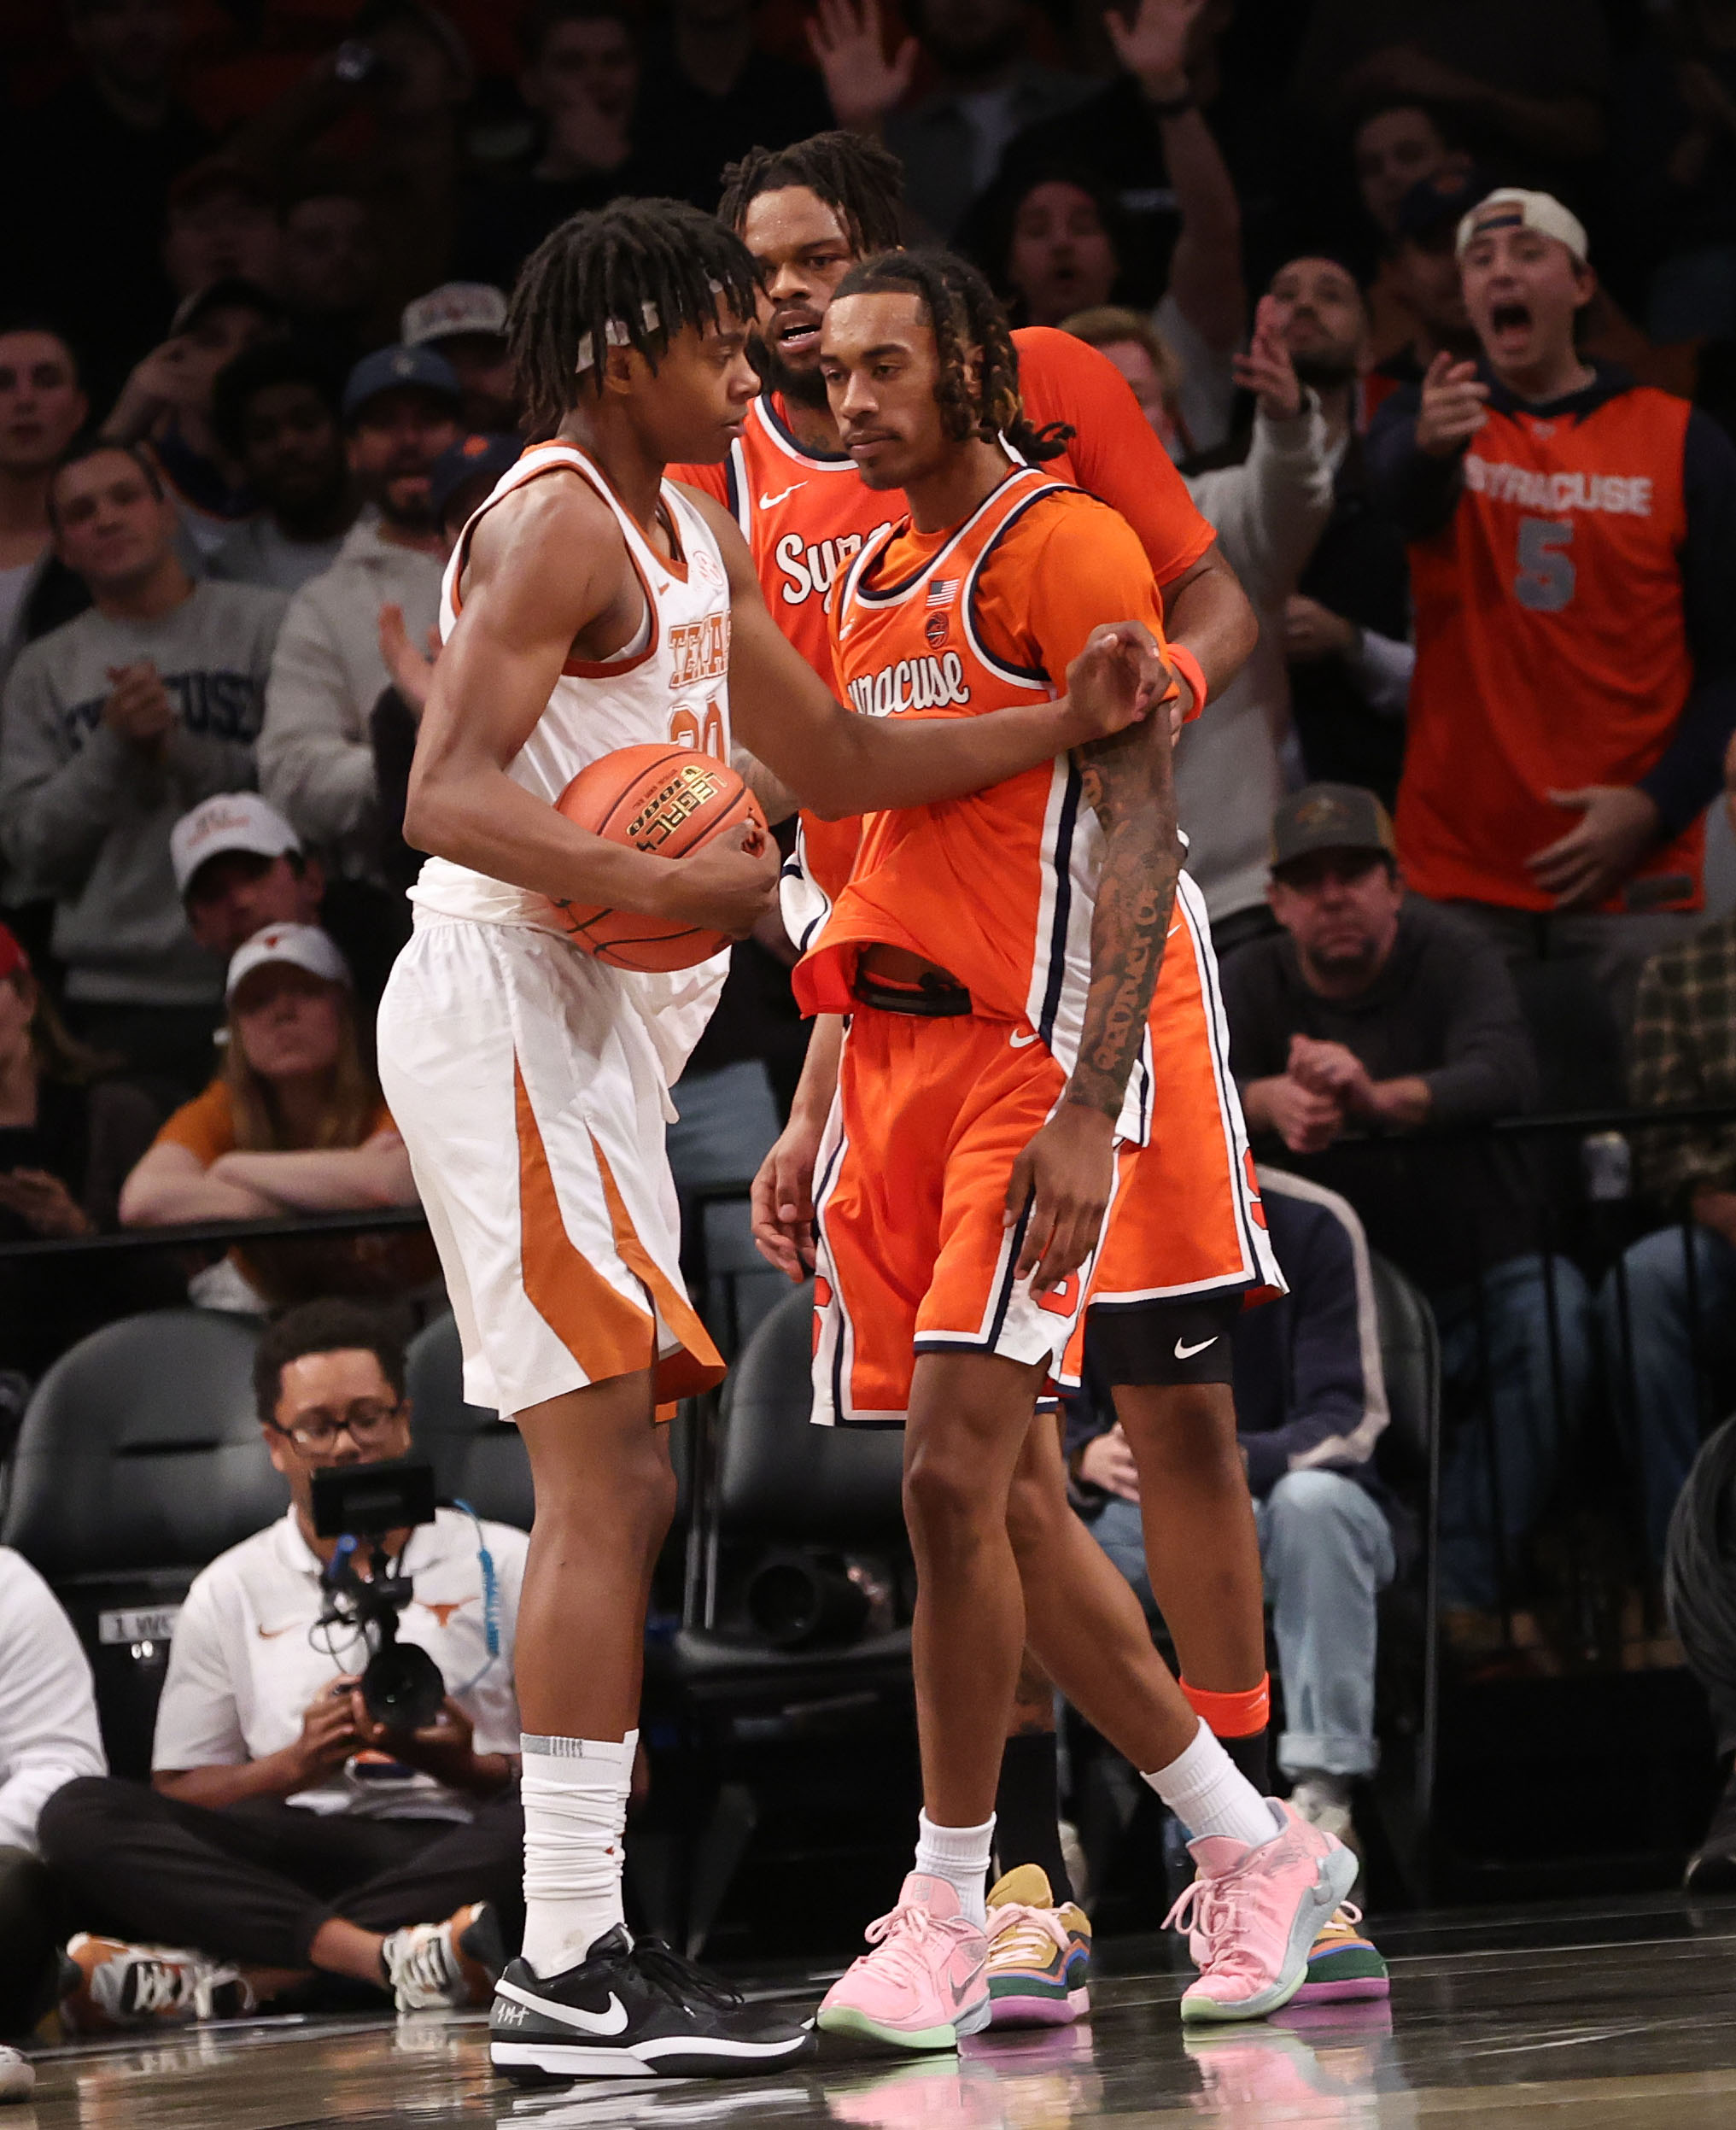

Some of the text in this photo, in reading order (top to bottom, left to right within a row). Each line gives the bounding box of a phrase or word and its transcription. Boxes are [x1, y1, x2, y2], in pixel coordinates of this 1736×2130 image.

[1464, 454, 1653, 516] SYRACUSE
[1515, 518, 1575, 612] 5
[669, 609, 731, 688] TEXA
[627, 777, 686, 836] 1000
